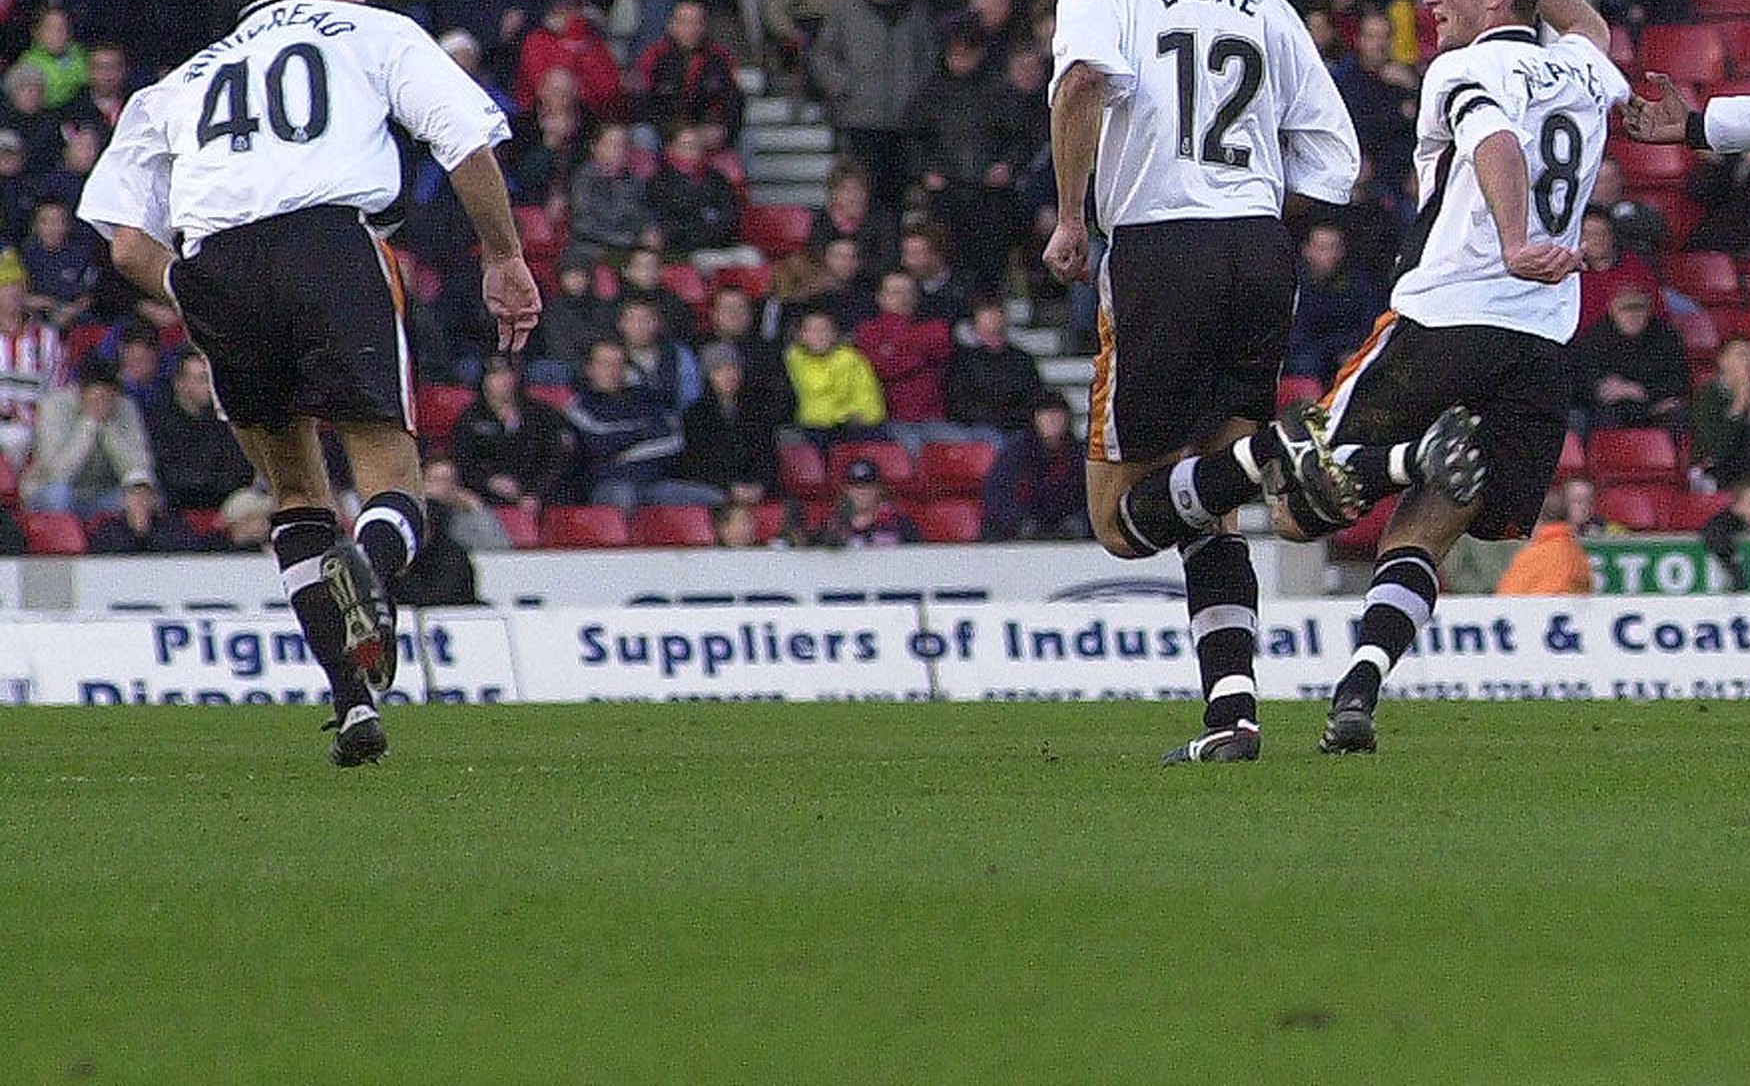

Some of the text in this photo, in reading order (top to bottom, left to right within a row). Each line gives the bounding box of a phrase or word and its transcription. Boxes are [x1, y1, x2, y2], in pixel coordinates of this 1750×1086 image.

[196, 41, 331, 152] 40
[1156, 28, 1266, 169] 12
[1534, 112, 1583, 238] 8
[153, 620, 455, 677] Pigmnt
[580, 622, 878, 676] Suppliers
[908, 620, 976, 661] of
[1003, 617, 1320, 661] Indusal
[1350, 614, 1518, 656] int
[1543, 616, 1585, 656] &
